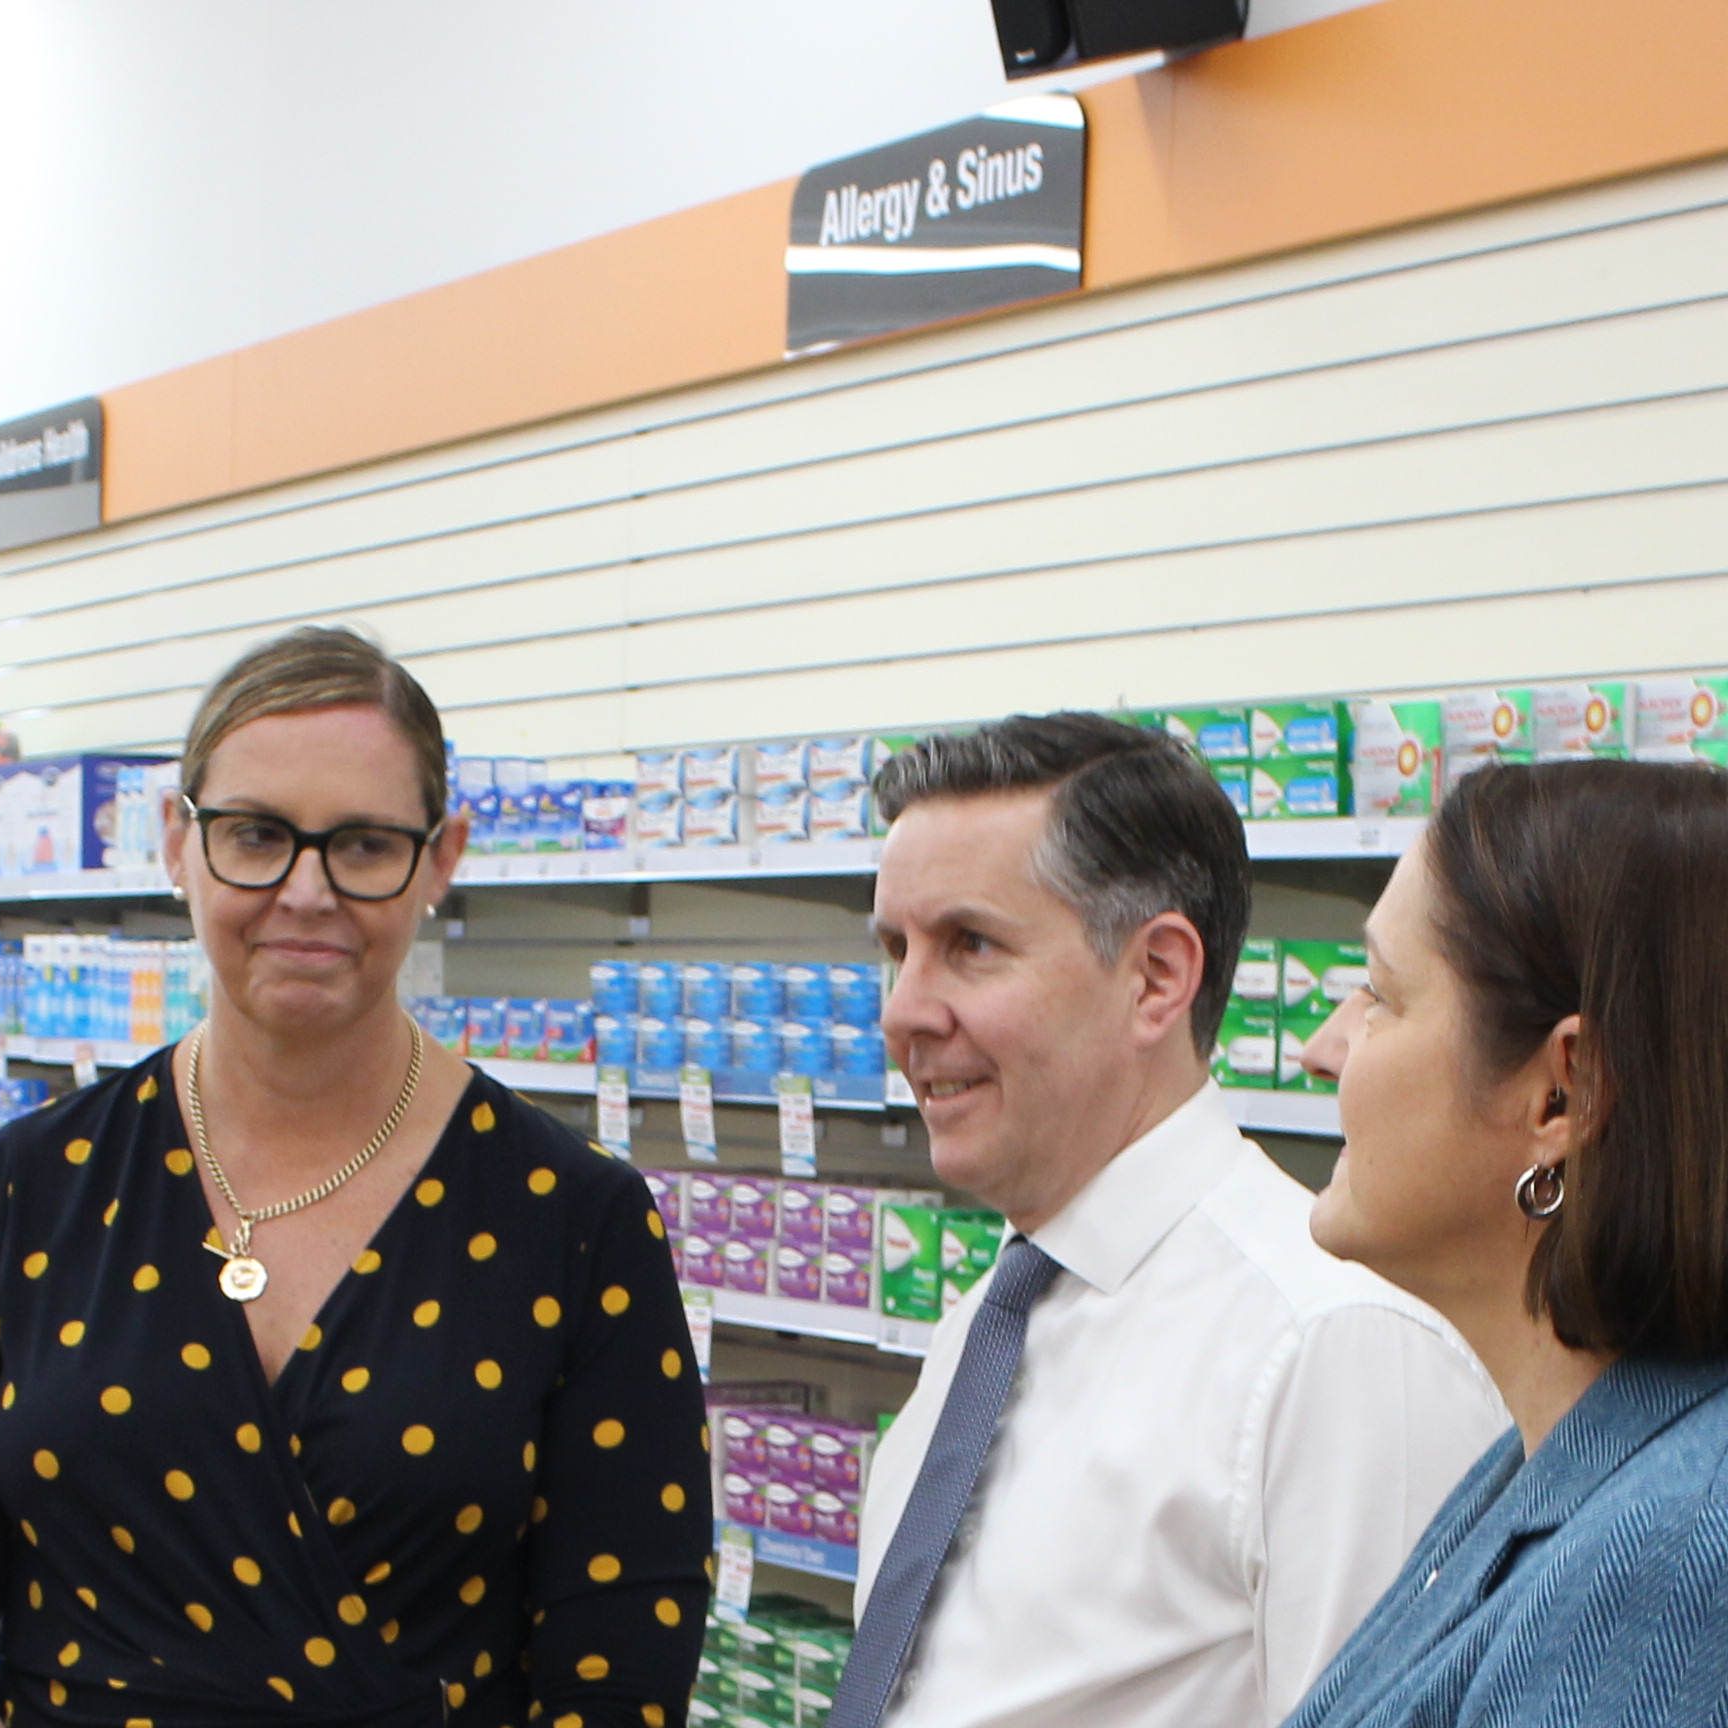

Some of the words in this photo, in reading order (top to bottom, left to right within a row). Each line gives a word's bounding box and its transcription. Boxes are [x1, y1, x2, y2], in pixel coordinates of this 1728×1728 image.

[820, 176, 922, 247] Allergy
[925, 158, 950, 219] &
[956, 141, 1044, 211] Sinus
[44, 419, 89, 466] Health
